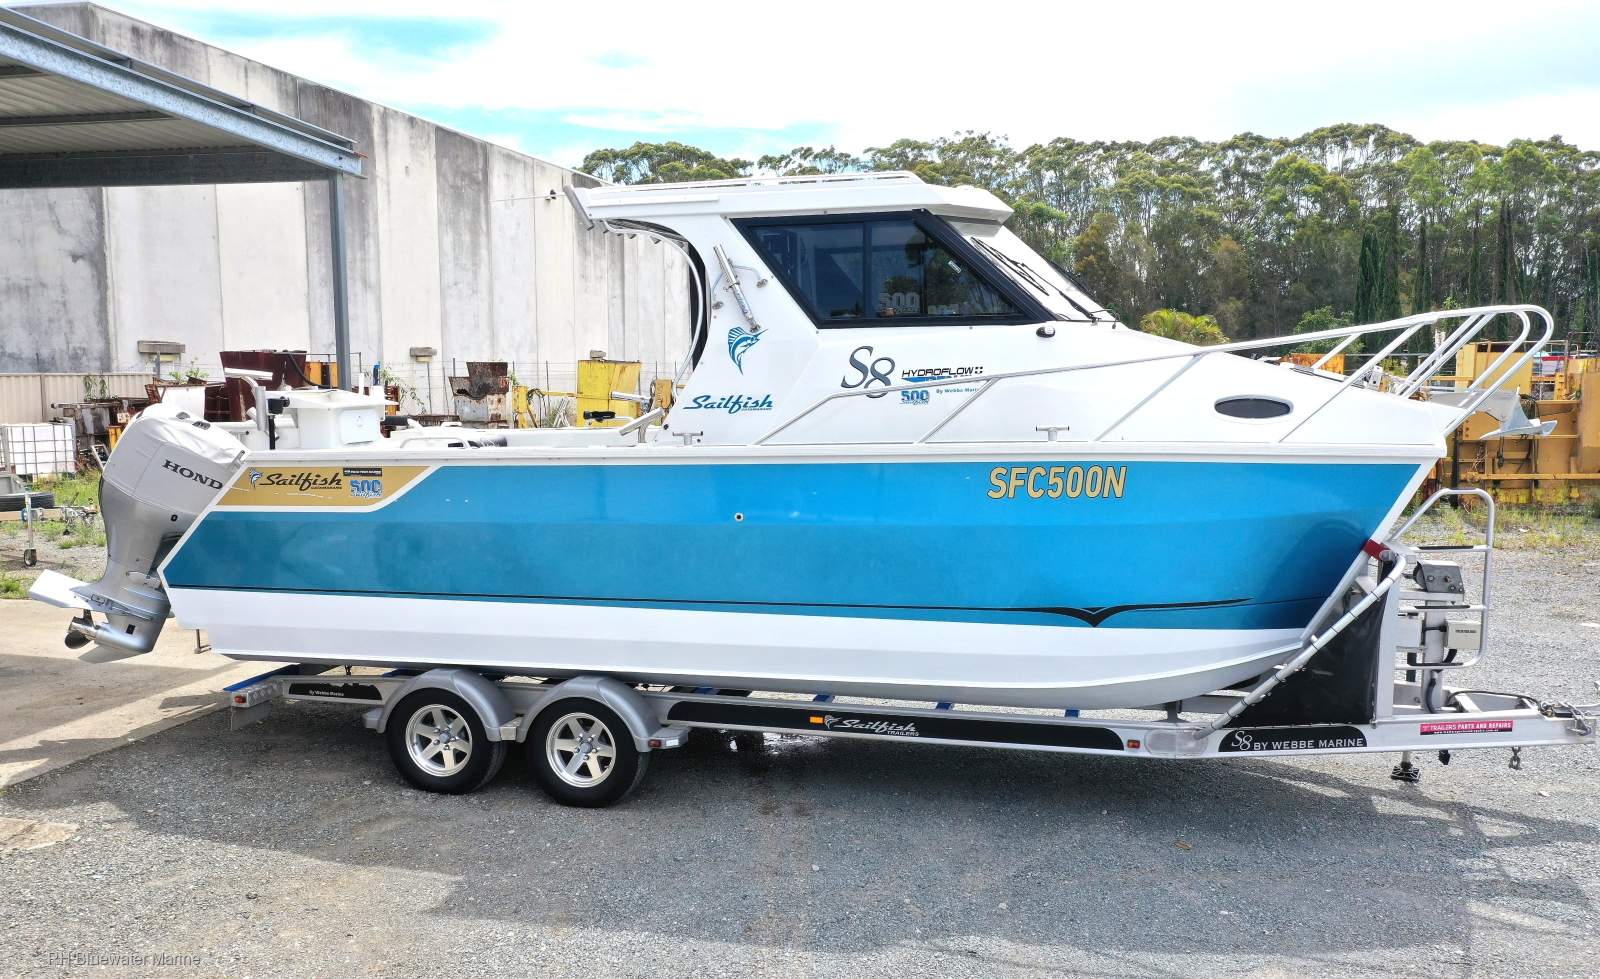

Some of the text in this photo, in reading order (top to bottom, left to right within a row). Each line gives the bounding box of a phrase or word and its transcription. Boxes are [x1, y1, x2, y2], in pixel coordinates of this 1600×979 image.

[840, 345, 895, 398] S8
[901, 366, 974, 377] HYDROFLOW
[683, 394, 773, 414] Sailfish
[901, 389, 929, 401] 500
[161, 459, 223, 490] HOND
[259, 472, 342, 491] Sailfish
[987, 465, 1127, 499] SFC500N
[834, 719, 916, 733] Sailfish
[1253, 742, 1268, 751] BY
[1272, 740, 1315, 750] WEBBE
[1318, 738, 1364, 748] MARINE
